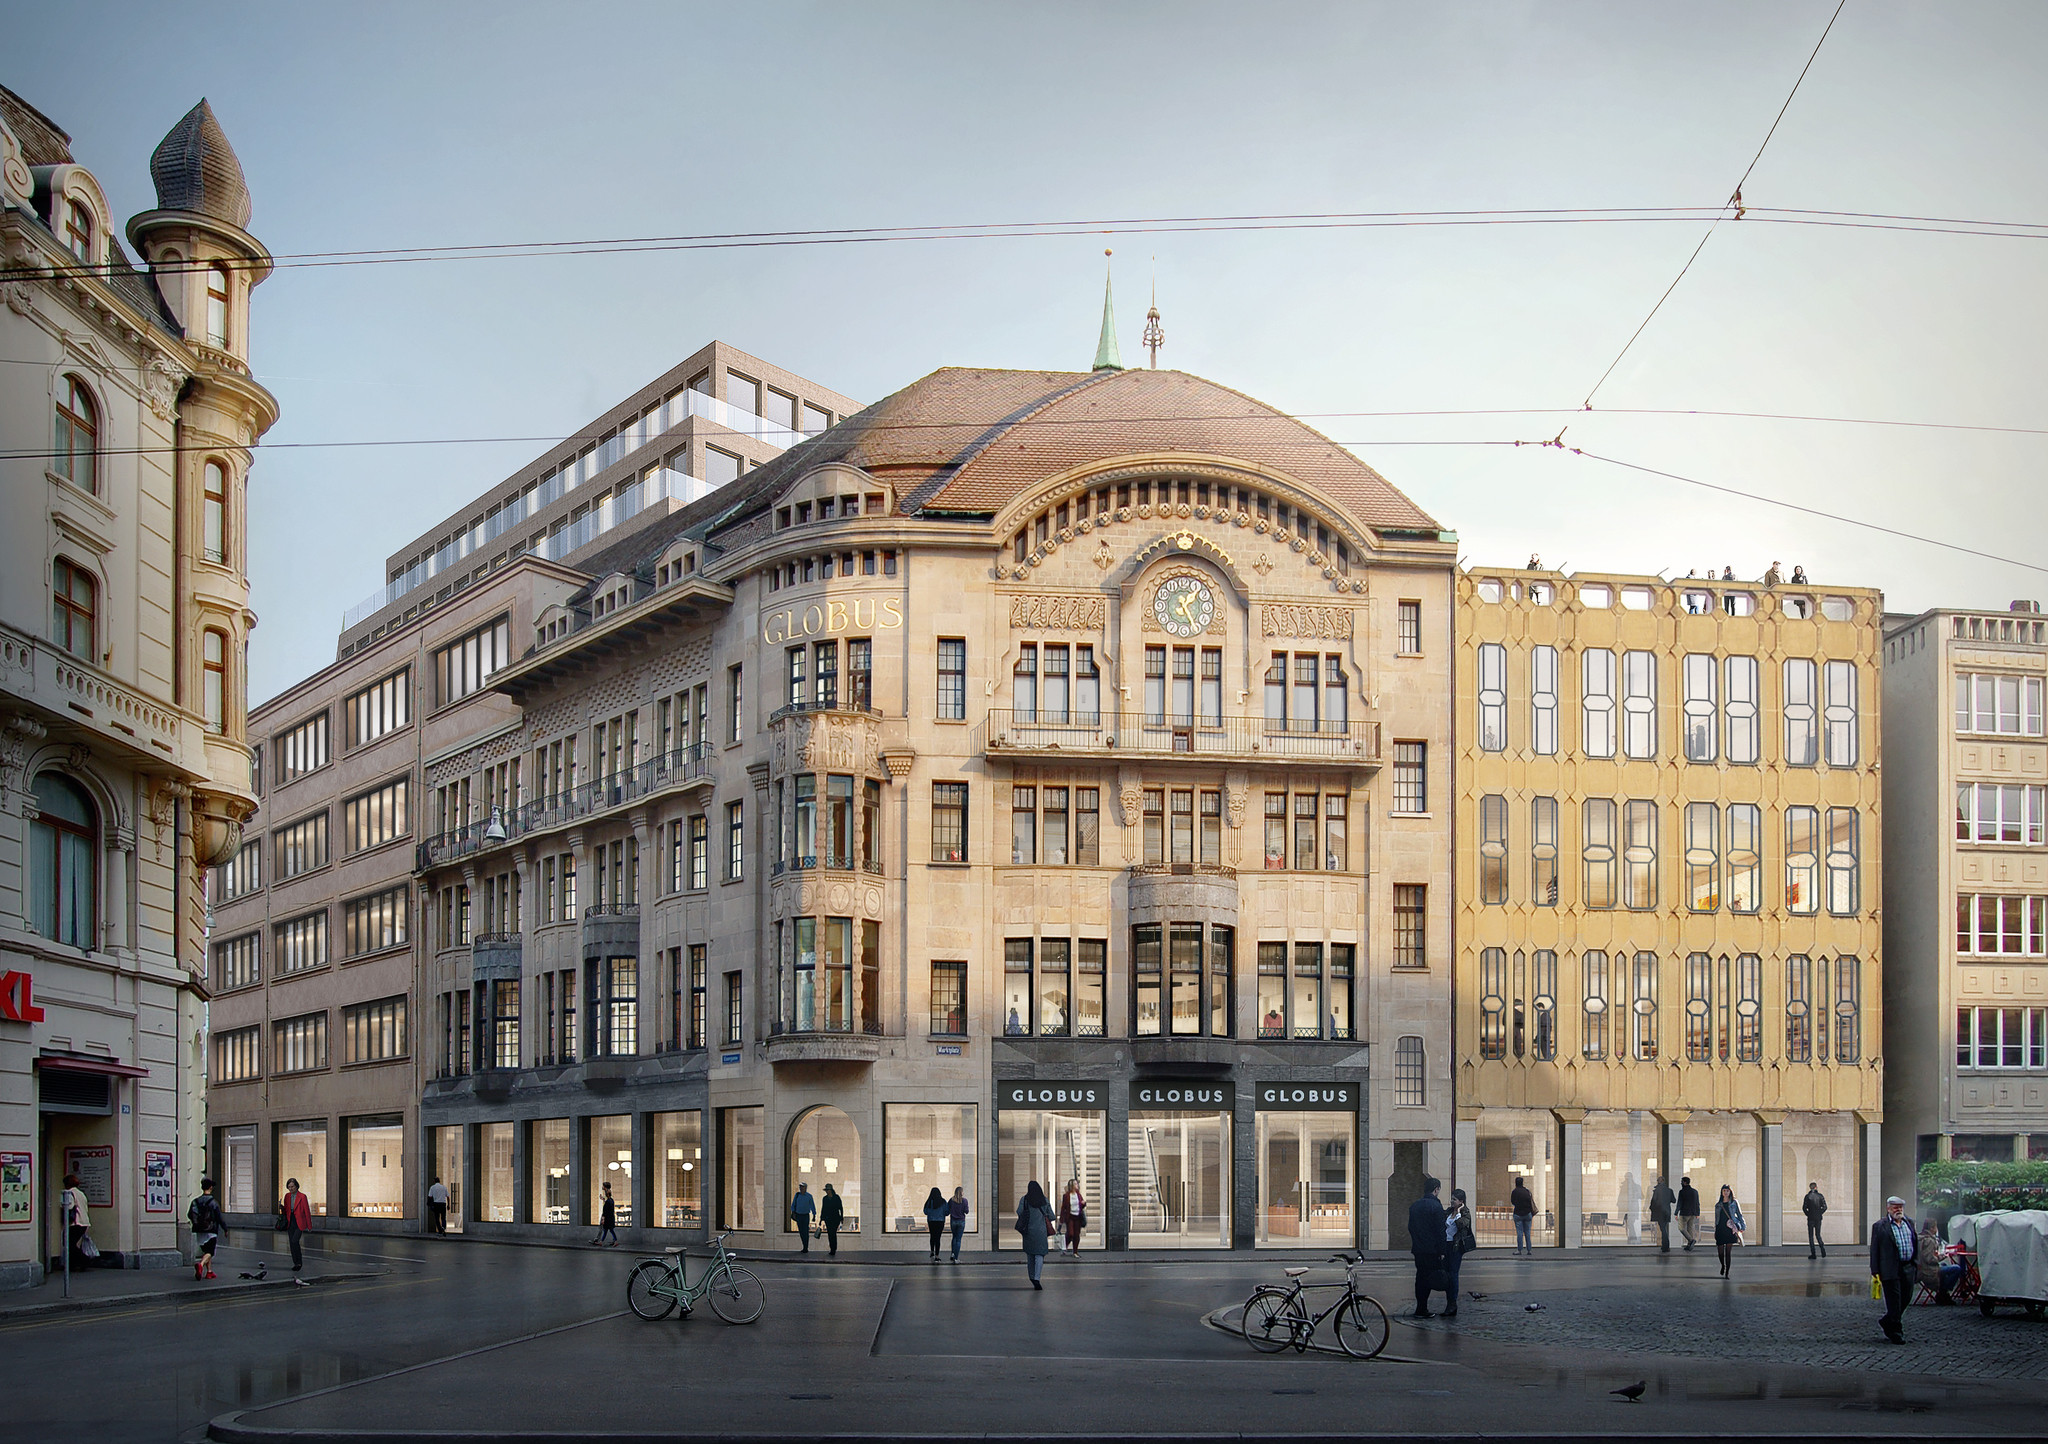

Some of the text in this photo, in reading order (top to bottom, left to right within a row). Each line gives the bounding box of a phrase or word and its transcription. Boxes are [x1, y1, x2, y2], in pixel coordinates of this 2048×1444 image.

[764, 597, 904, 645] GLOBUS
[1012, 1089, 1096, 1102] GLOBUS
[1139, 1089, 1223, 1103] GLOBUS
[1264, 1089, 1348, 1103] GLOBUS
